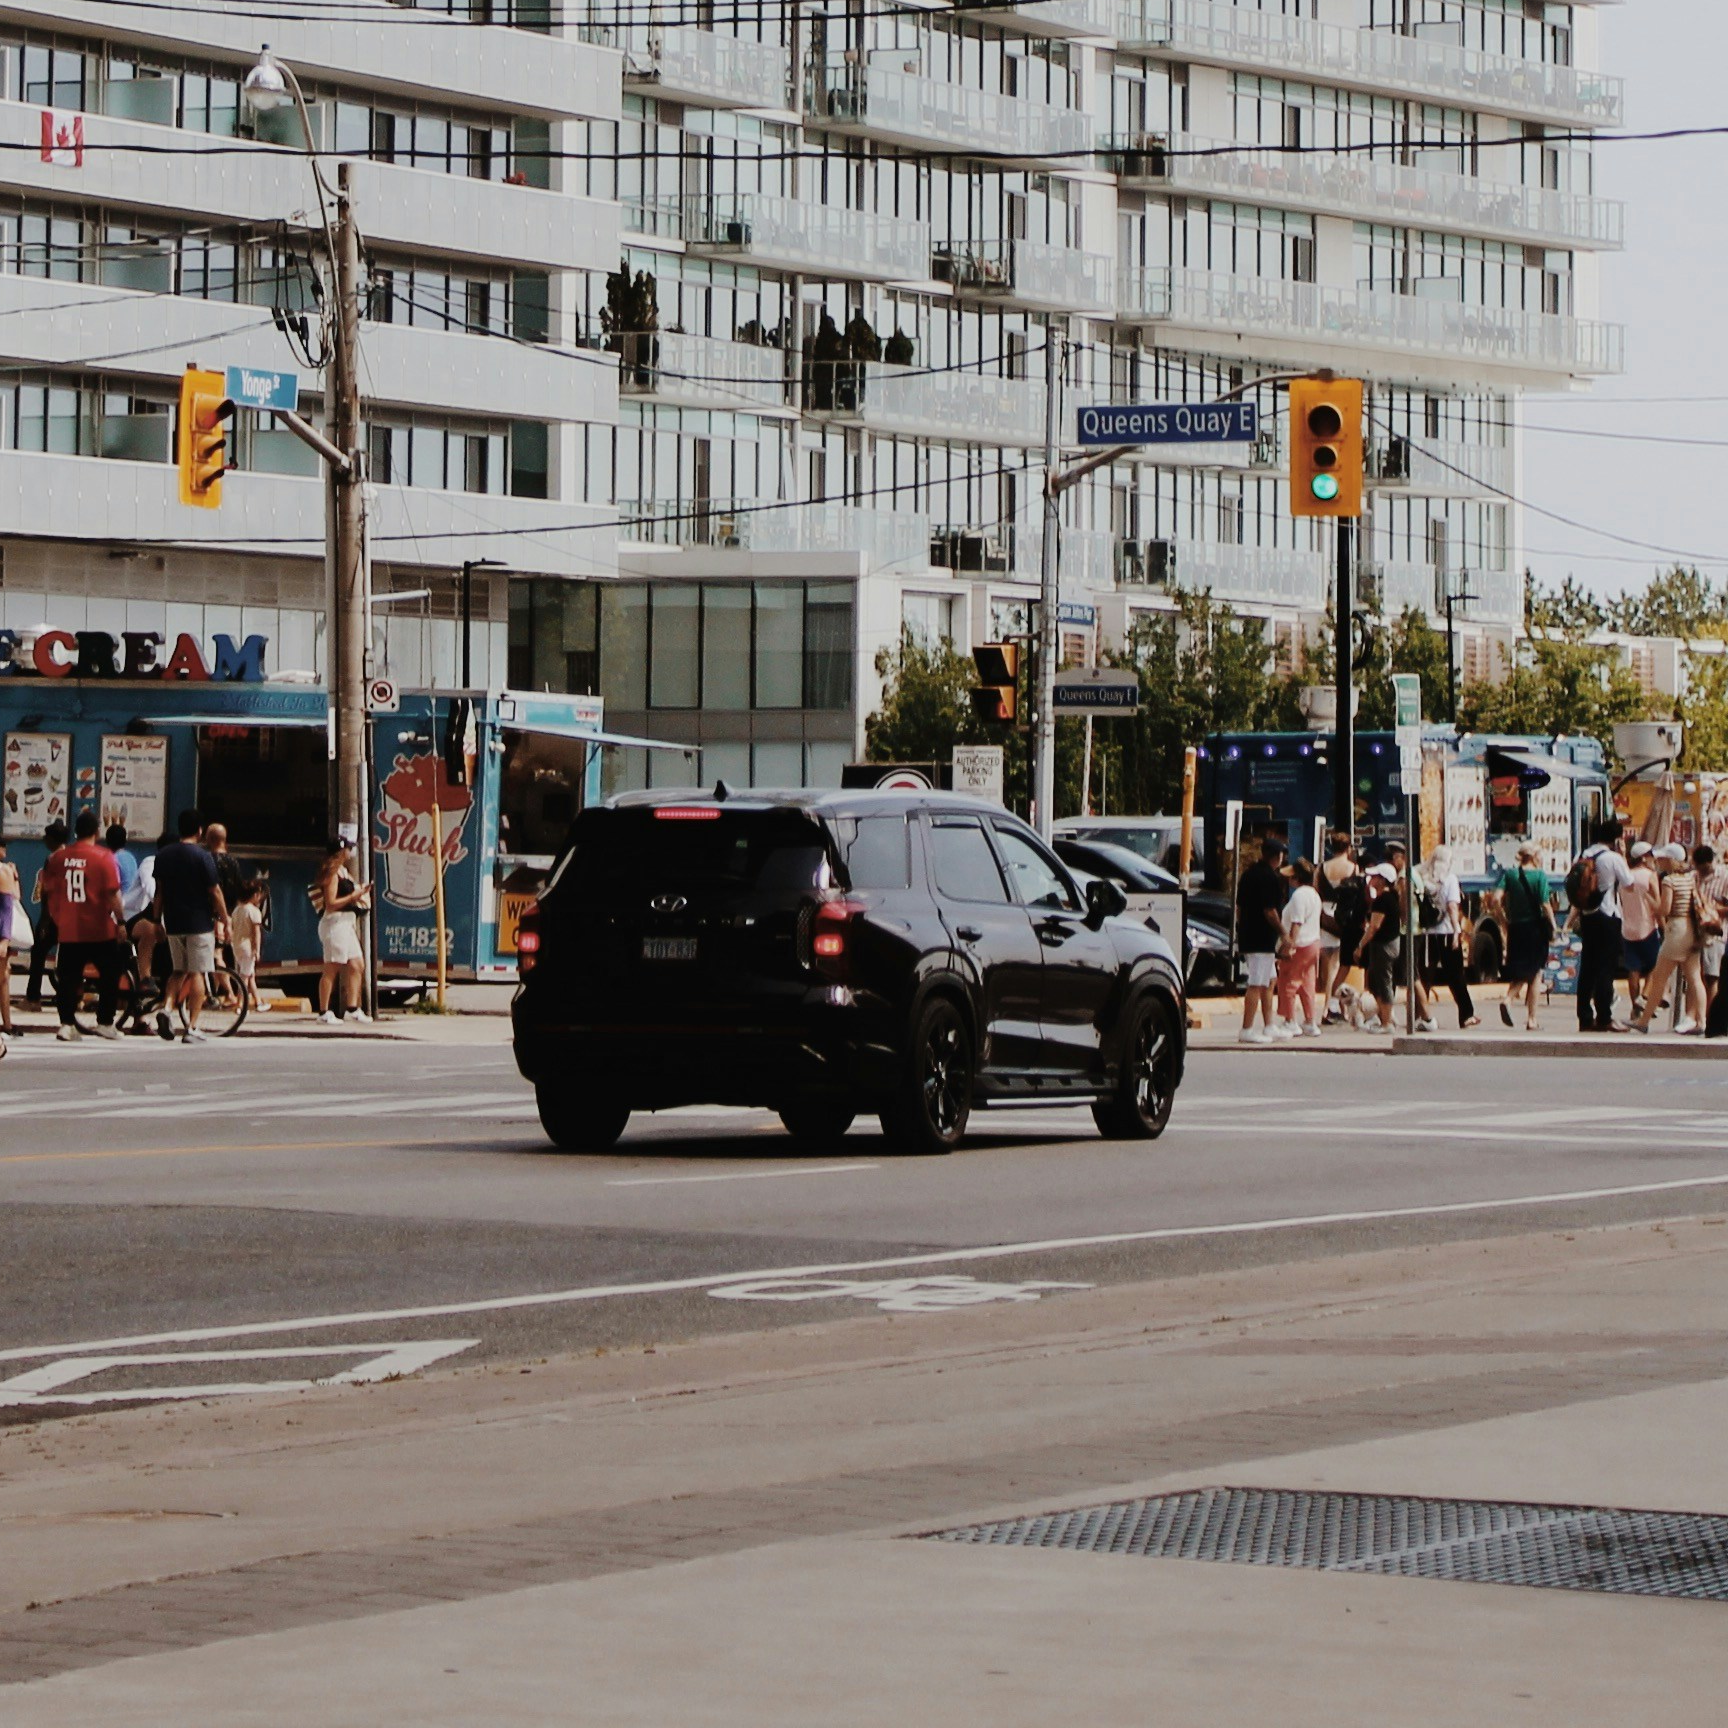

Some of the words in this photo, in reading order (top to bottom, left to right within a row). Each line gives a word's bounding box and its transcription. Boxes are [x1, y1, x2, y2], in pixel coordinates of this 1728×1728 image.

[241, 369, 273, 406] Yonge
[1083, 409, 1168, 438] Queens
[1175, 407, 1232, 439] Quay
[1239, 405, 1252, 432] E
[33, 629, 269, 683] CREAM
[1059, 687, 1097, 701] Queens
[1099, 687, 1124, 704] Quay
[956, 756, 1000, 767] AUTHORIZED
[962, 766, 993, 776] PARKING
[969, 776, 986, 786] ONLY
[65, 869, 87, 903] 19
